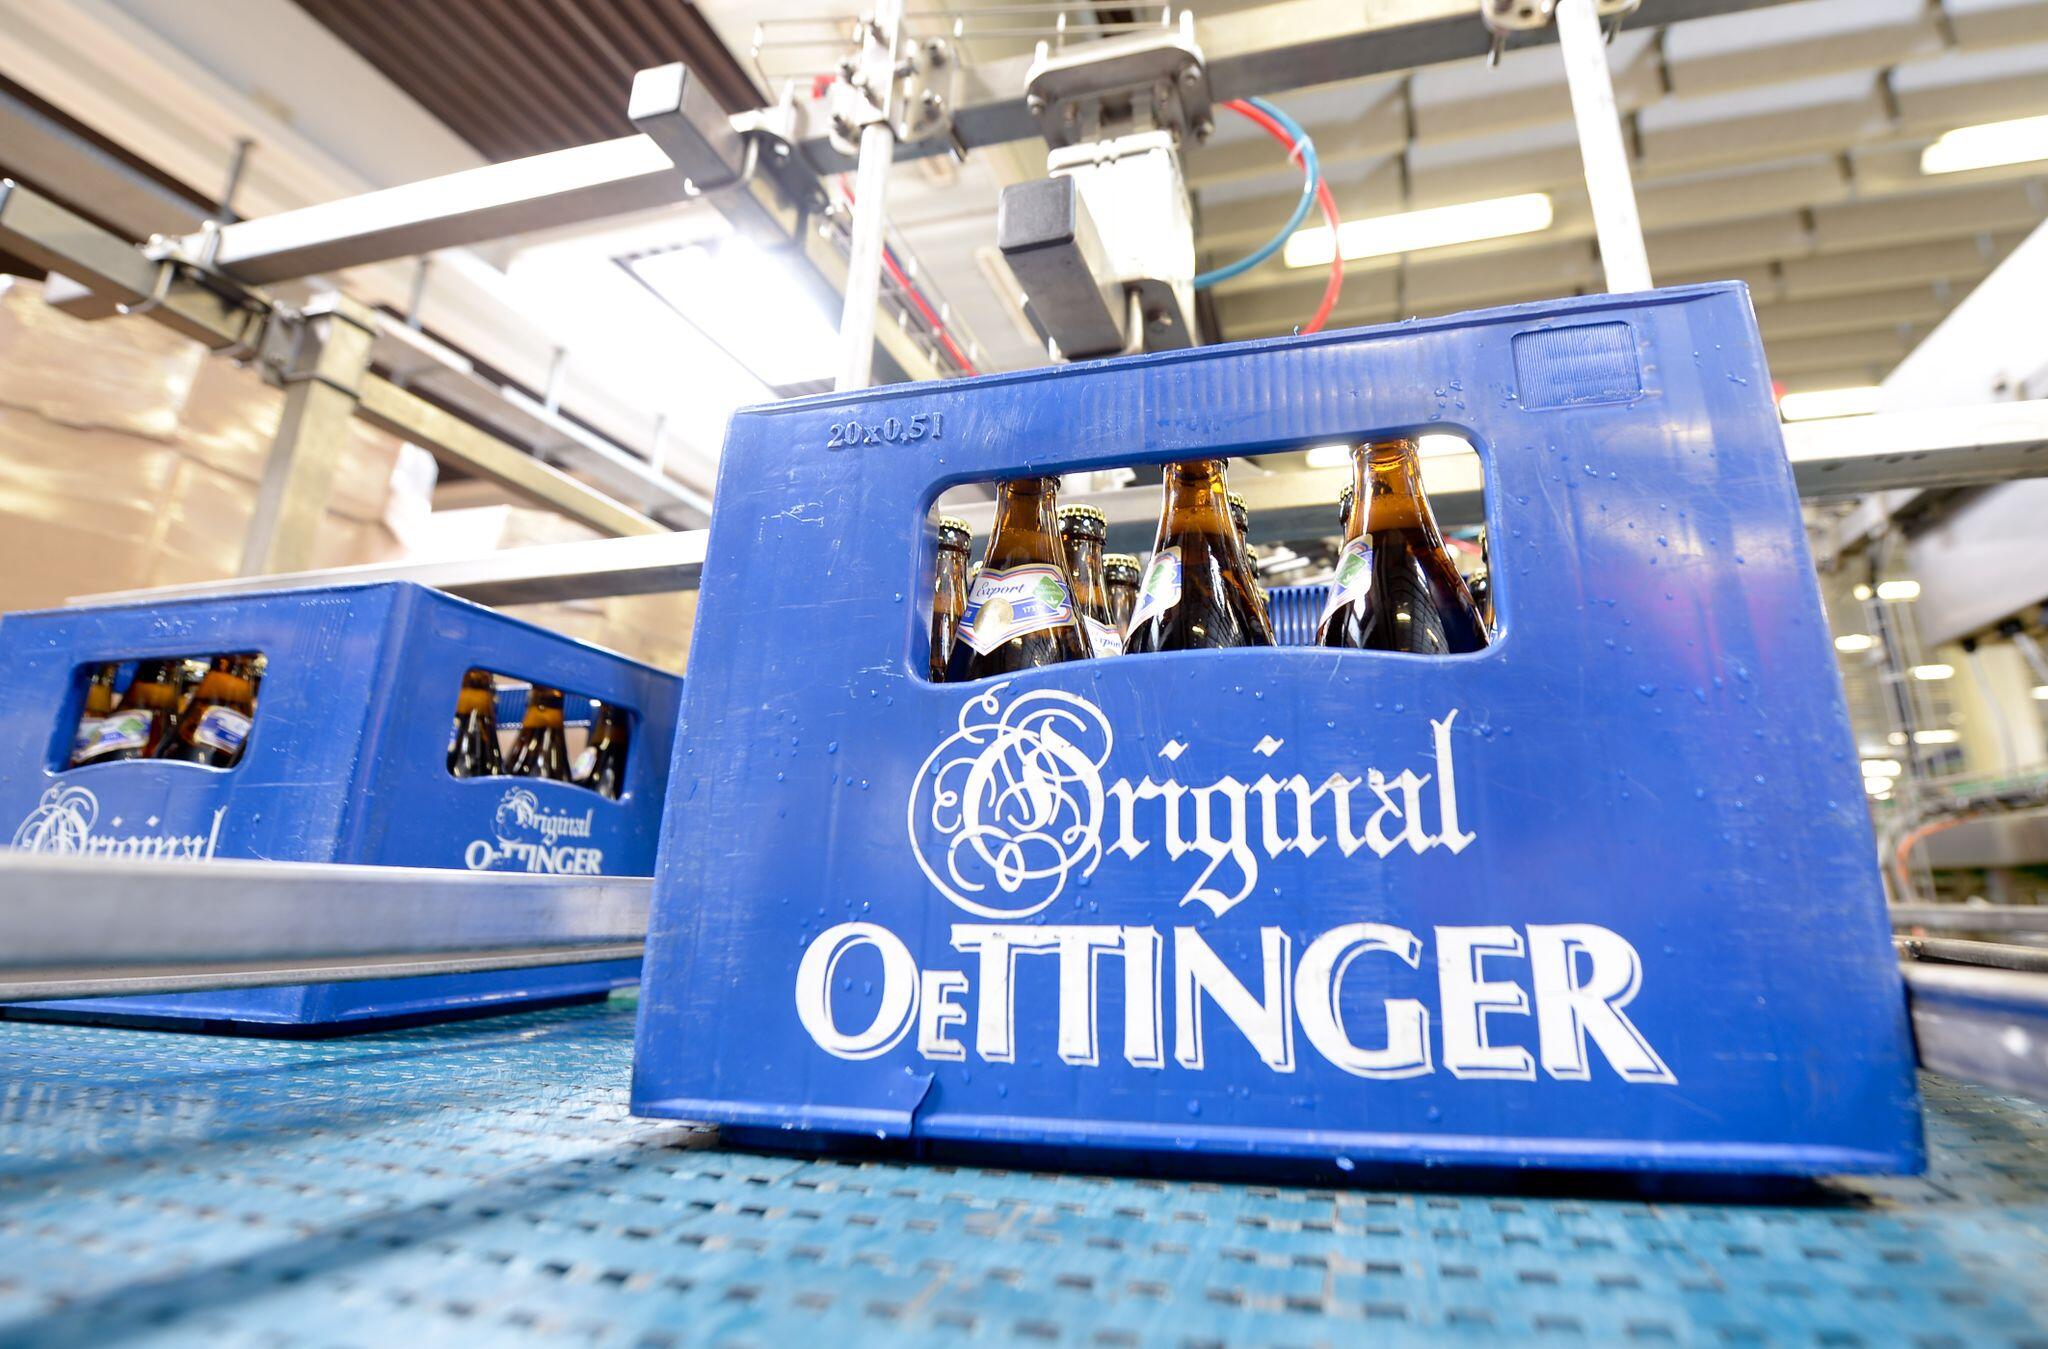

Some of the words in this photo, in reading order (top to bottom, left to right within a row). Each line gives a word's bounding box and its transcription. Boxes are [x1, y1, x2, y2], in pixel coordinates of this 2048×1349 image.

[976, 581, 1025, 598] Export
[907, 682, 1476, 919] Original
[794, 921, 1678, 1085] OETTINGER
